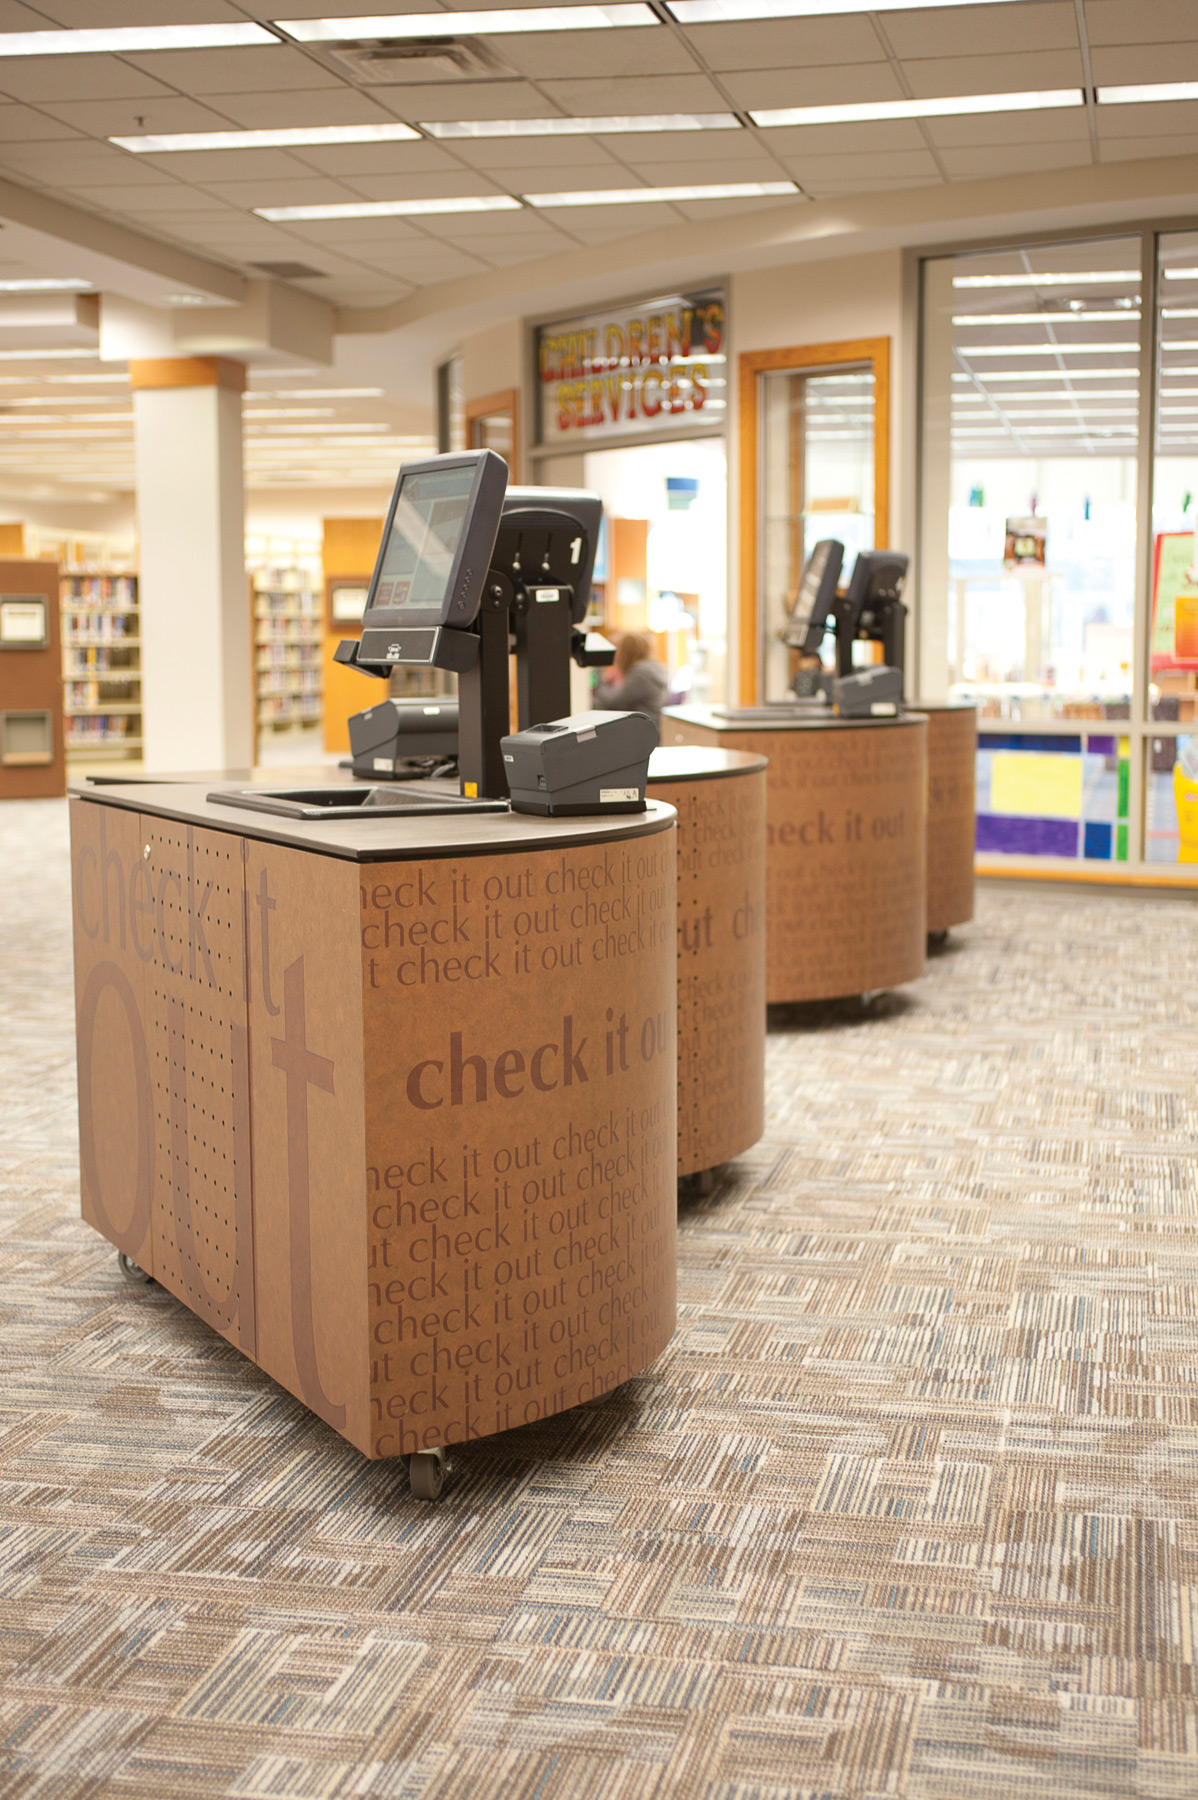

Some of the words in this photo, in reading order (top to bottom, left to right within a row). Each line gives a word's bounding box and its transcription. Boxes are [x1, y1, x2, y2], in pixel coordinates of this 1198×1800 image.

[557, 363, 708, 430] SERVICES
[570, 536, 583, 565] 1
[362, 905, 470, 950] check
[485, 904, 503, 940] it
[513, 903, 561, 937] out
[570, 885, 631, 929] check
[637, 883, 646, 916] it
[452, 868, 471, 904] it
[484, 867, 533, 901] out
[545, 851, 614, 895] check
[622, 850, 632, 884] it
[397, 940, 501, 986] check
[514, 940, 532, 974] it
[541, 937, 582, 971] out
[592, 917, 645, 961] check
[406, 1015, 589, 1110] check
[605, 1007, 629, 1077] it
[463, 1144, 482, 1180] it
[494, 1138, 541, 1173] out
[553, 1110, 619, 1160] check
[626, 1106, 636, 1138] it
[79, 954, 346, 1430] out
[372, 1181, 481, 1229] check
[494, 1177, 512, 1211] it
[523, 1168, 566, 1204] out
[577, 1140, 635, 1191] check
[409, 1212, 511, 1263] check
[523, 1208, 539, 1242] it
[549, 1199, 589, 1235] out
[598, 1168, 648, 1219] check
[464, 1257, 483, 1292] it
[494, 1248, 542, 1285] out
[553, 1217, 620, 1270] check
[626, 1211, 636, 1244] it
[374, 1293, 481, 1345] check
[494, 1289, 512, 1324] it
[523, 1277, 567, 1315] out
[577, 1245, 636, 1298] check
[410, 1333, 512, 1377] check
[523, 1319, 540, 1352] it
[550, 1306, 589, 1343] out
[598, 1273, 649, 1326] check
[464, 1370, 483, 1403] it
[494, 1357, 543, 1396] out
[553, 1324, 620, 1378] check
[626, 1317, 637, 1345] it
[375, 1406, 482, 1458] check
[496, 1401, 512, 1433] it
[524, 1385, 567, 1424] out
